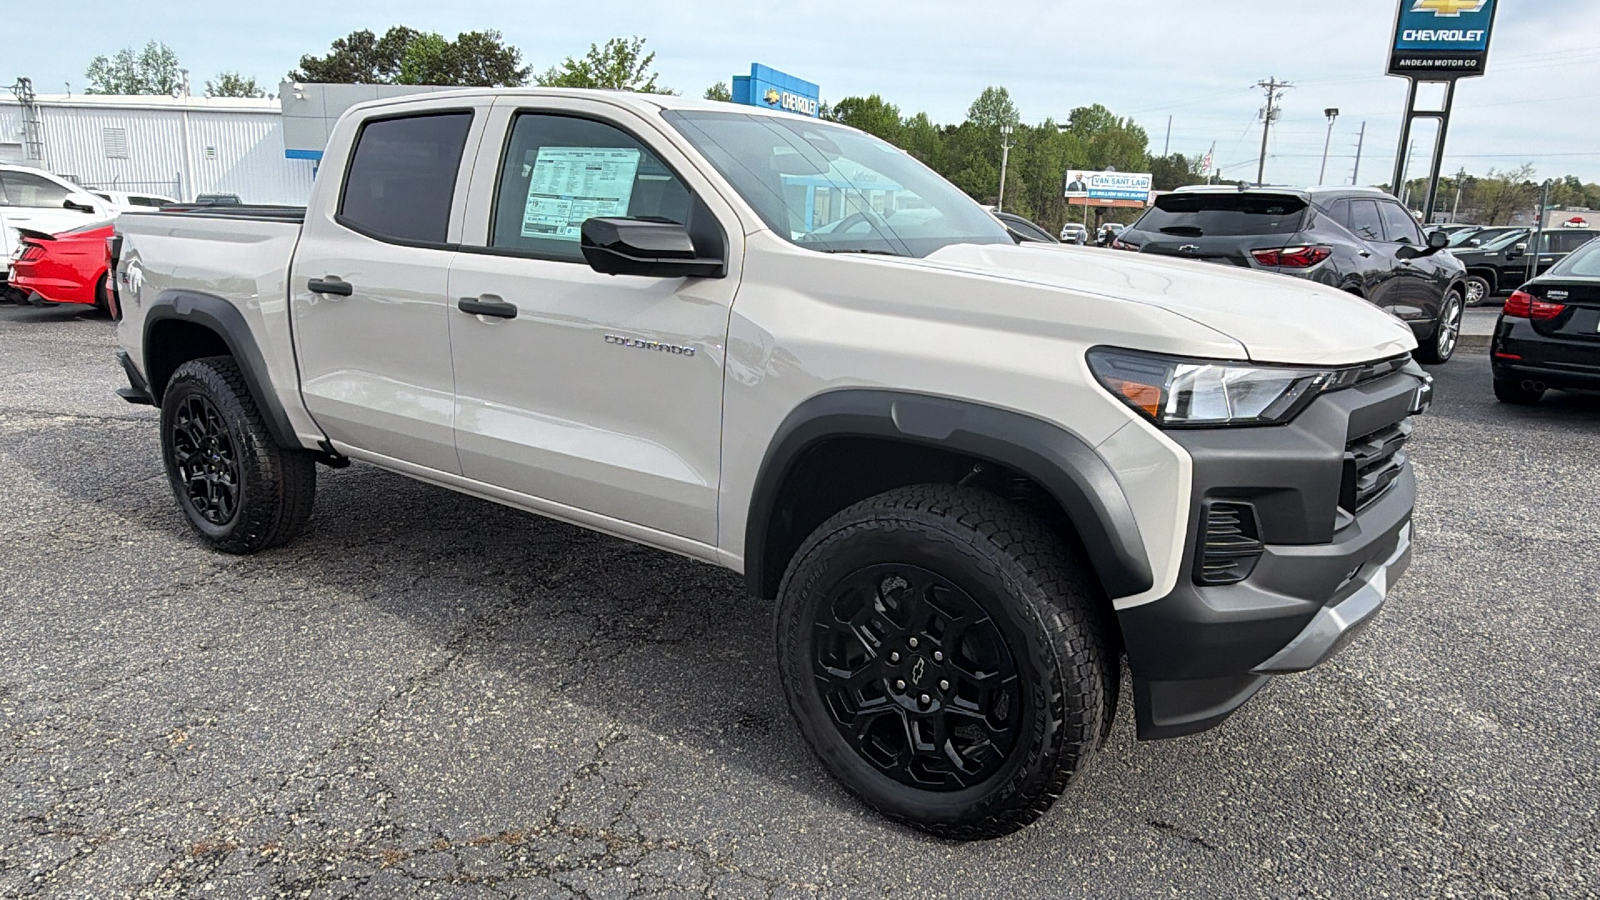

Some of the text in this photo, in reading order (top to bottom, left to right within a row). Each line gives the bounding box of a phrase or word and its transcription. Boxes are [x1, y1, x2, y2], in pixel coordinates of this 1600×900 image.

[1402, 29, 1485, 41] CHEVROLET
[1434, 59, 1463, 67] MOTOR
[1464, 59, 1477, 67] CO
[782, 92, 818, 115] CHEVROLET
[604, 334, 696, 356] COLORADO
